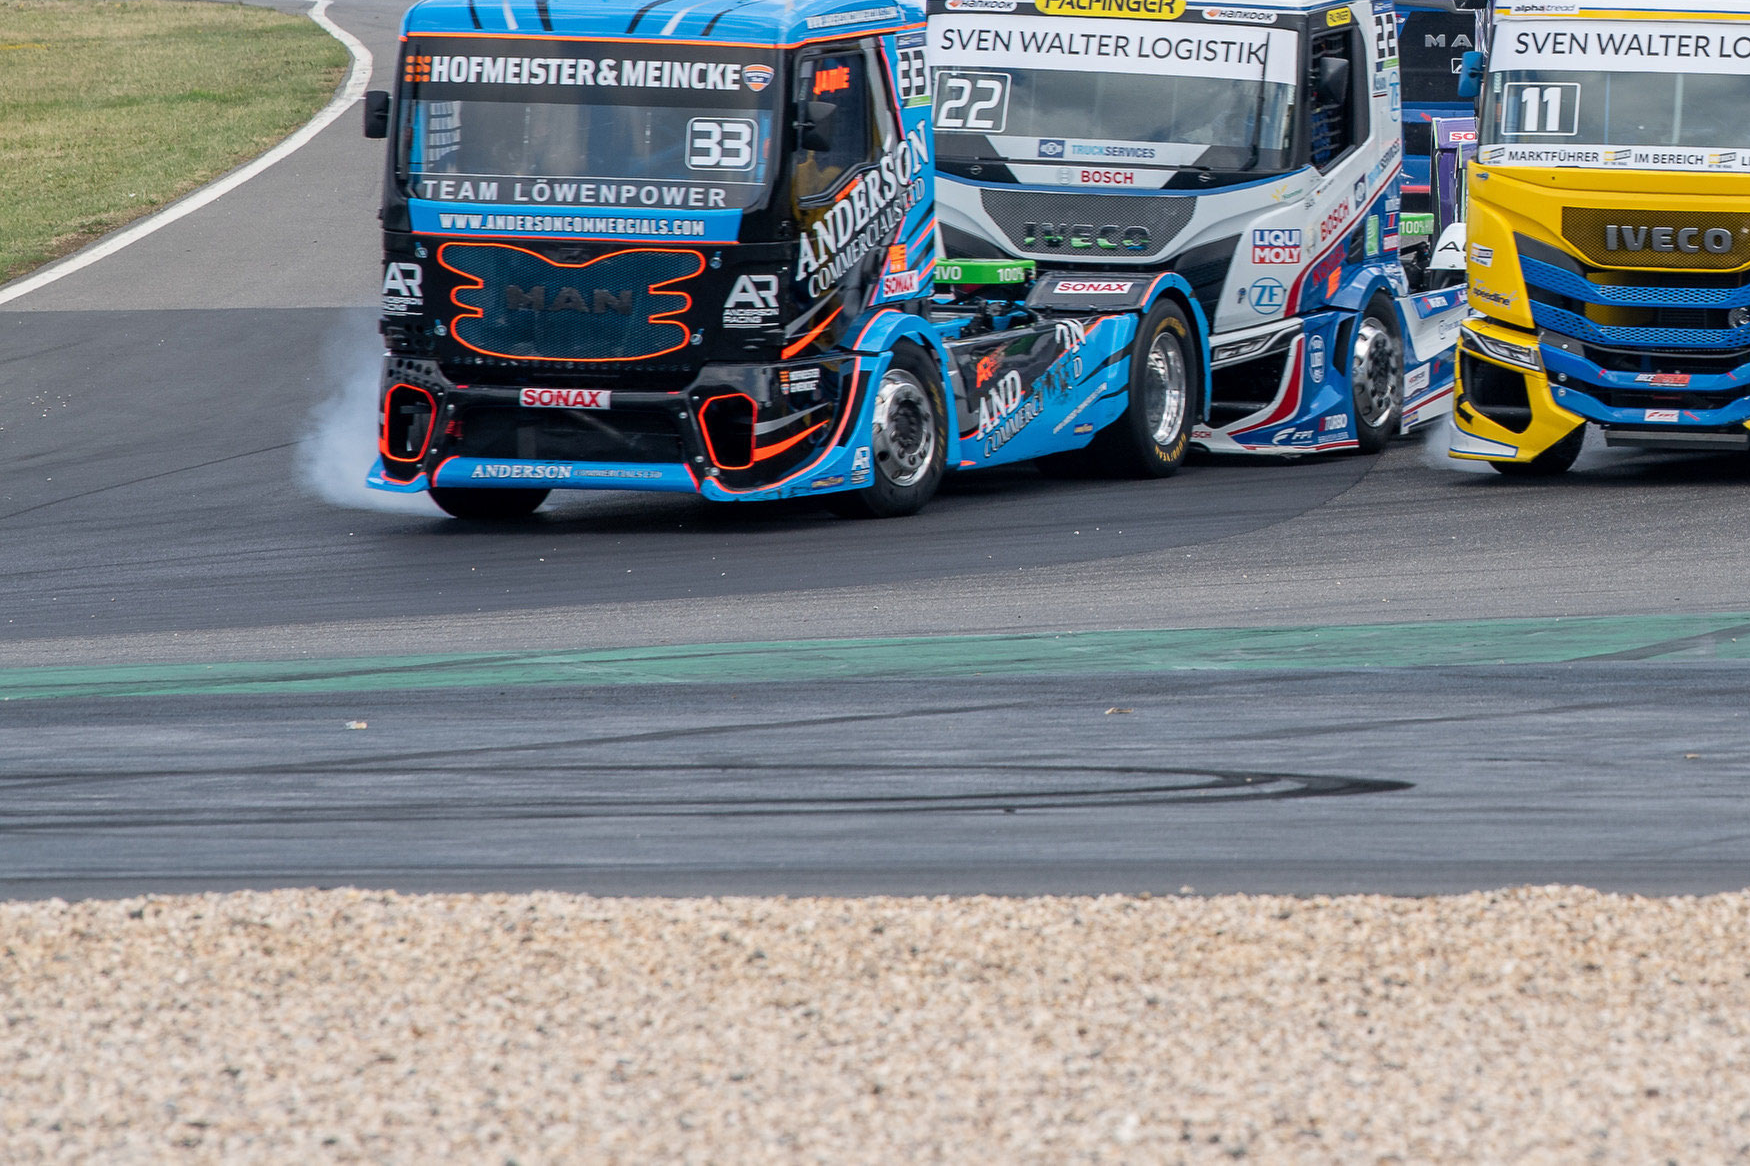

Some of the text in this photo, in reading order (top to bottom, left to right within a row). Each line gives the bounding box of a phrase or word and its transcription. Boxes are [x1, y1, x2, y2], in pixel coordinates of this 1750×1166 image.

[941, 28, 1268, 66] SVEN WALTER LOGISTIK
[1515, 32, 1588, 54] SVEN
[1597, 33, 1711, 58] WALTER
[430, 55, 595, 88] HOFMEISTER
[621, 59, 741, 91] MEINCKE
[936, 78, 1003, 129] 22
[1521, 87, 1562, 132] 11
[690, 122, 751, 167] 33
[1072, 144, 1156, 159] TRUCKSERVICES
[1508, 149, 1599, 163] MARKTFÜHRER
[1634, 153, 1649, 164] IM
[1652, 153, 1704, 166] BEREICH
[1081, 170, 1134, 185] BOSCH
[423, 178, 727, 208] TEAM LÖWENPOWER
[795, 119, 929, 282] ANDERSON
[439, 212, 704, 236] WWW.ANDERSONCOMMERCIALS.COM
[1024, 221, 1151, 250] IVECO
[1254, 230, 1300, 246] LIQUI
[1606, 224, 1732, 254] IVECO
[1254, 247, 1301, 263] MOLY
[723, 275, 779, 307] AR
[883, 272, 916, 295] SONAX
[1056, 282, 1128, 292] SONAX
[507, 285, 633, 314] MAN
[722, 308, 779, 316] ANDERSON
[722, 316, 762, 324] RACING
[522, 388, 602, 408] SONAX
[471, 464, 573, 479] ANDERSON
